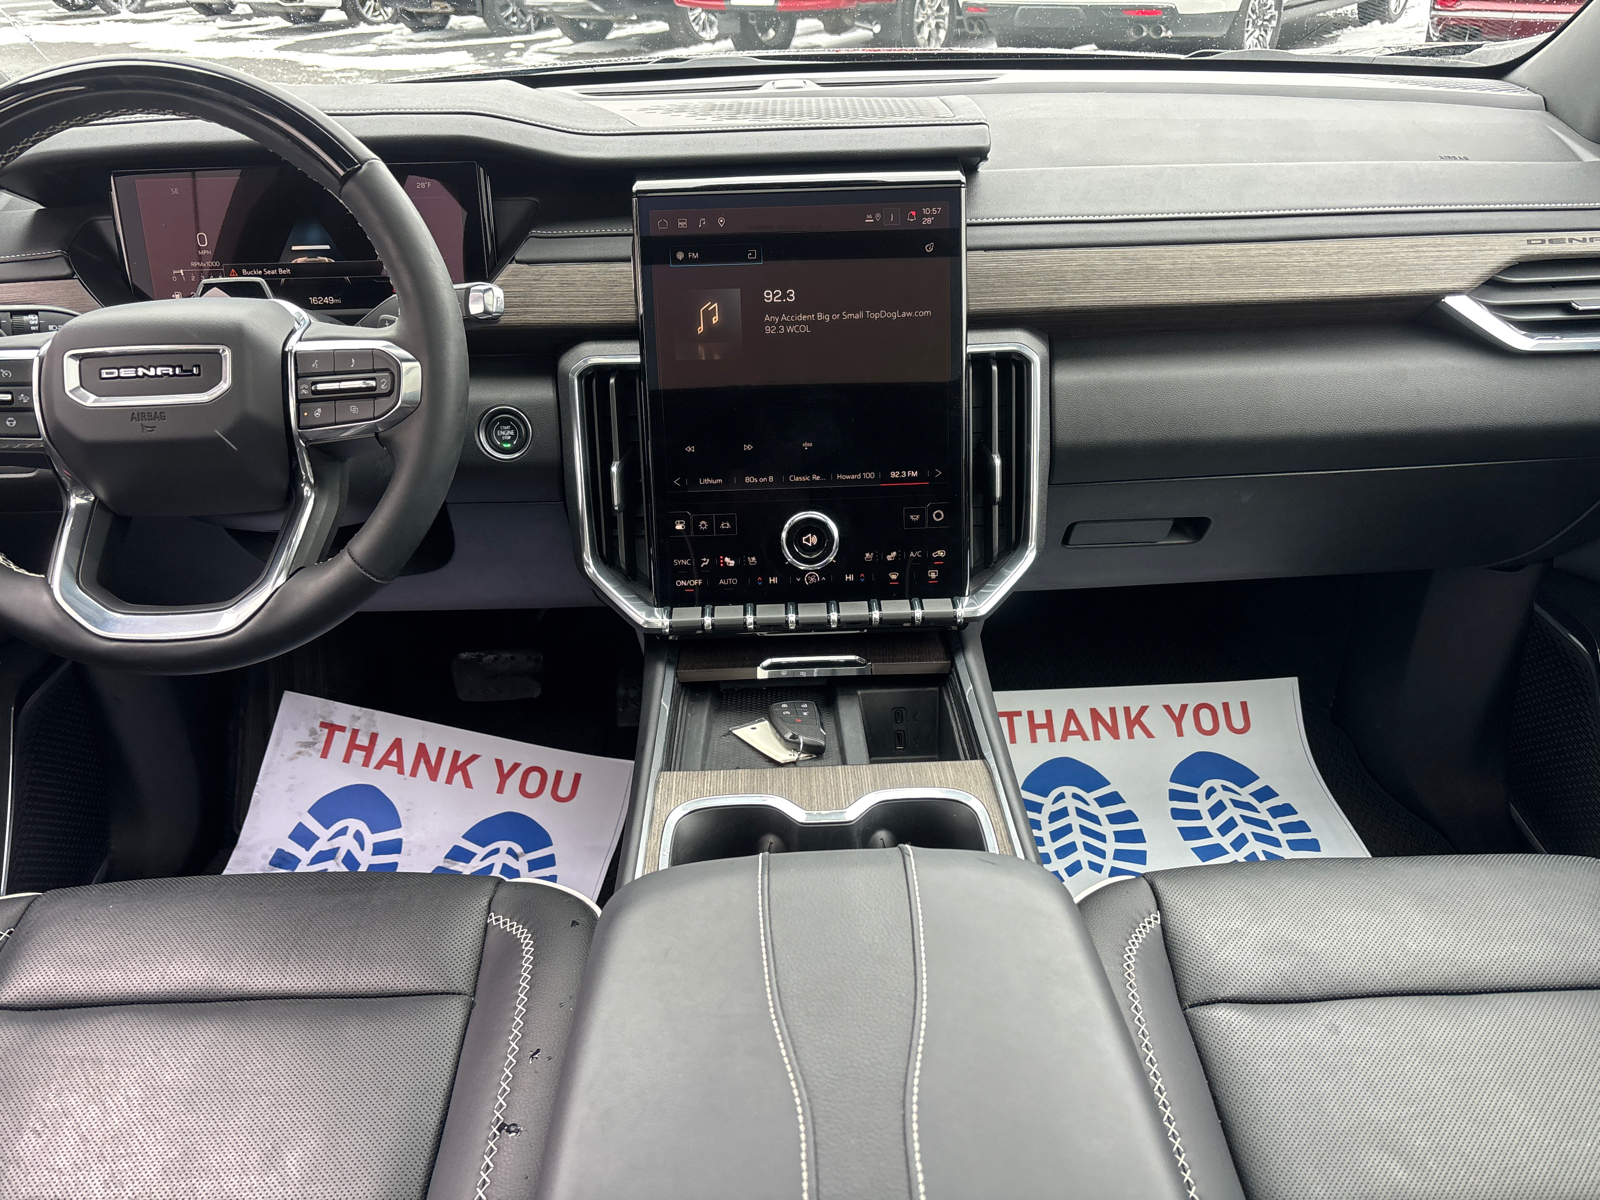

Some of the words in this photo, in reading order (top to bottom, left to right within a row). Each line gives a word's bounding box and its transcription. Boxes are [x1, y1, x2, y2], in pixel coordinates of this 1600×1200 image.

[922, 207, 942, 215] 10:57
[922, 217, 934, 225] 28°
[196, 232, 208, 247] 0
[279, 267, 292, 275] Belt
[763, 289, 796, 303] 92.3
[764, 314, 780, 324] Any
[780, 313, 816, 322] Accident
[817, 312, 831, 322] Big
[842, 310, 865, 320] Small
[865, 309, 932, 320] TopDogLaw.com
[764, 325, 785, 334] 92.3
[786, 324, 812, 333] WCOL
[100, 365, 201, 379] DENALI
[130, 411, 167, 422] AIRBAG
[789, 474, 811, 482] Classic
[890, 470, 906, 478] 92.3
[909, 550, 922, 558] A/C
[768, 576, 778, 584] HI
[998, 705, 1155, 745] THANK
[1162, 700, 1252, 738] YOU
[318, 721, 481, 790] THANK
[493, 757, 582, 803] YOU
